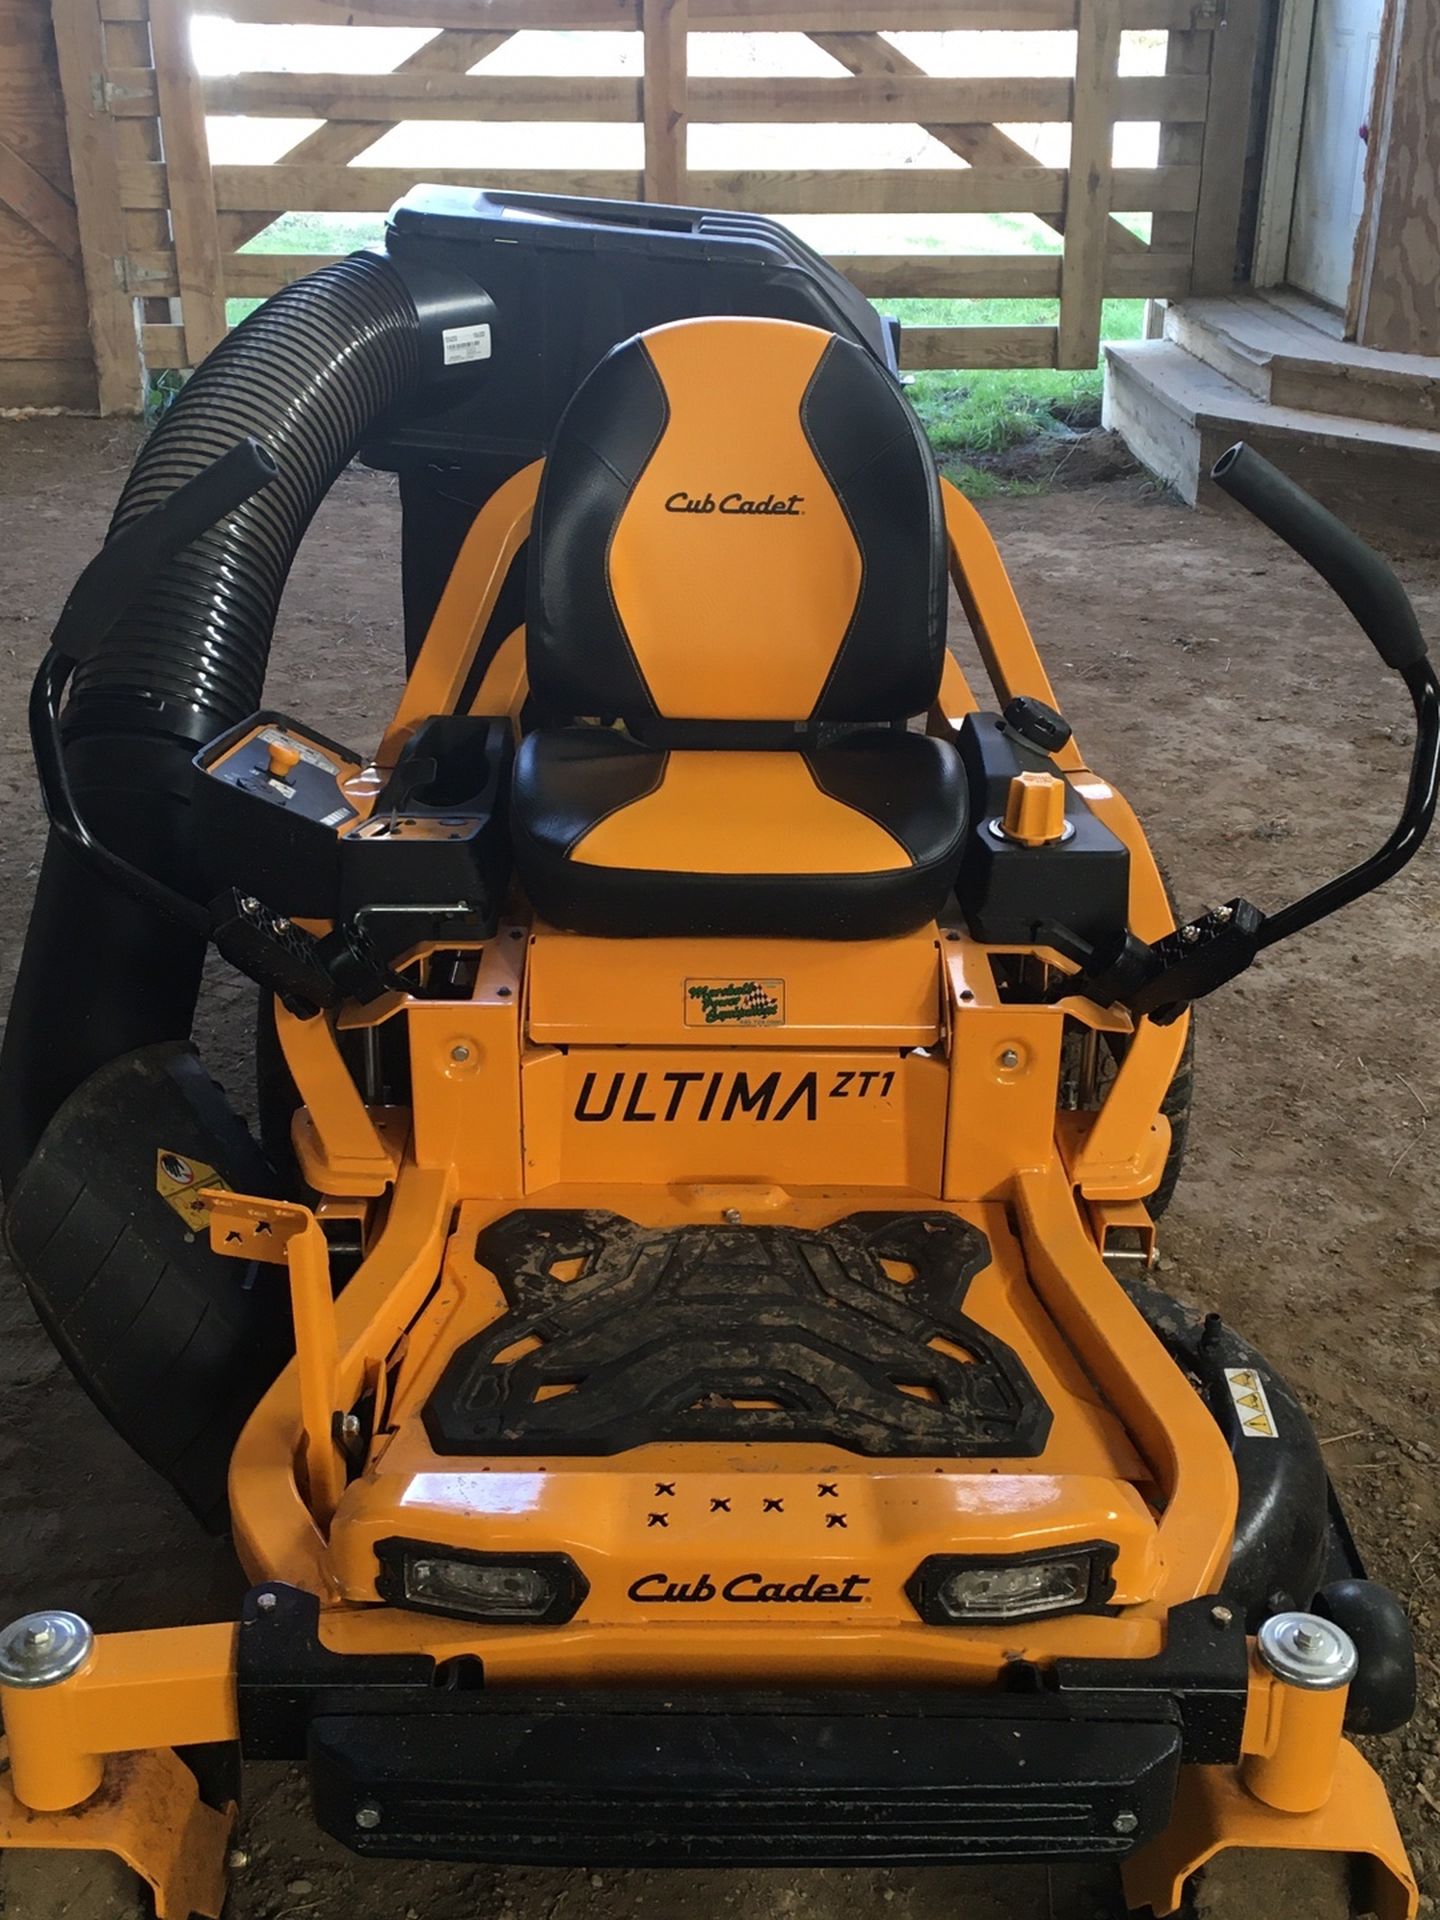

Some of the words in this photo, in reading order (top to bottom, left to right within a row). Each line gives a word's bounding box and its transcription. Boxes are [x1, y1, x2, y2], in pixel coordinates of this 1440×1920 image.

[665, 492, 716, 514] Cub
[719, 493, 805, 515] Cadet
[574, 1071, 817, 1122] ULTIMA
[828, 1071, 896, 1097] ZT1
[627, 1573, 717, 1602] Cub
[722, 1573, 871, 1603] Cadet
